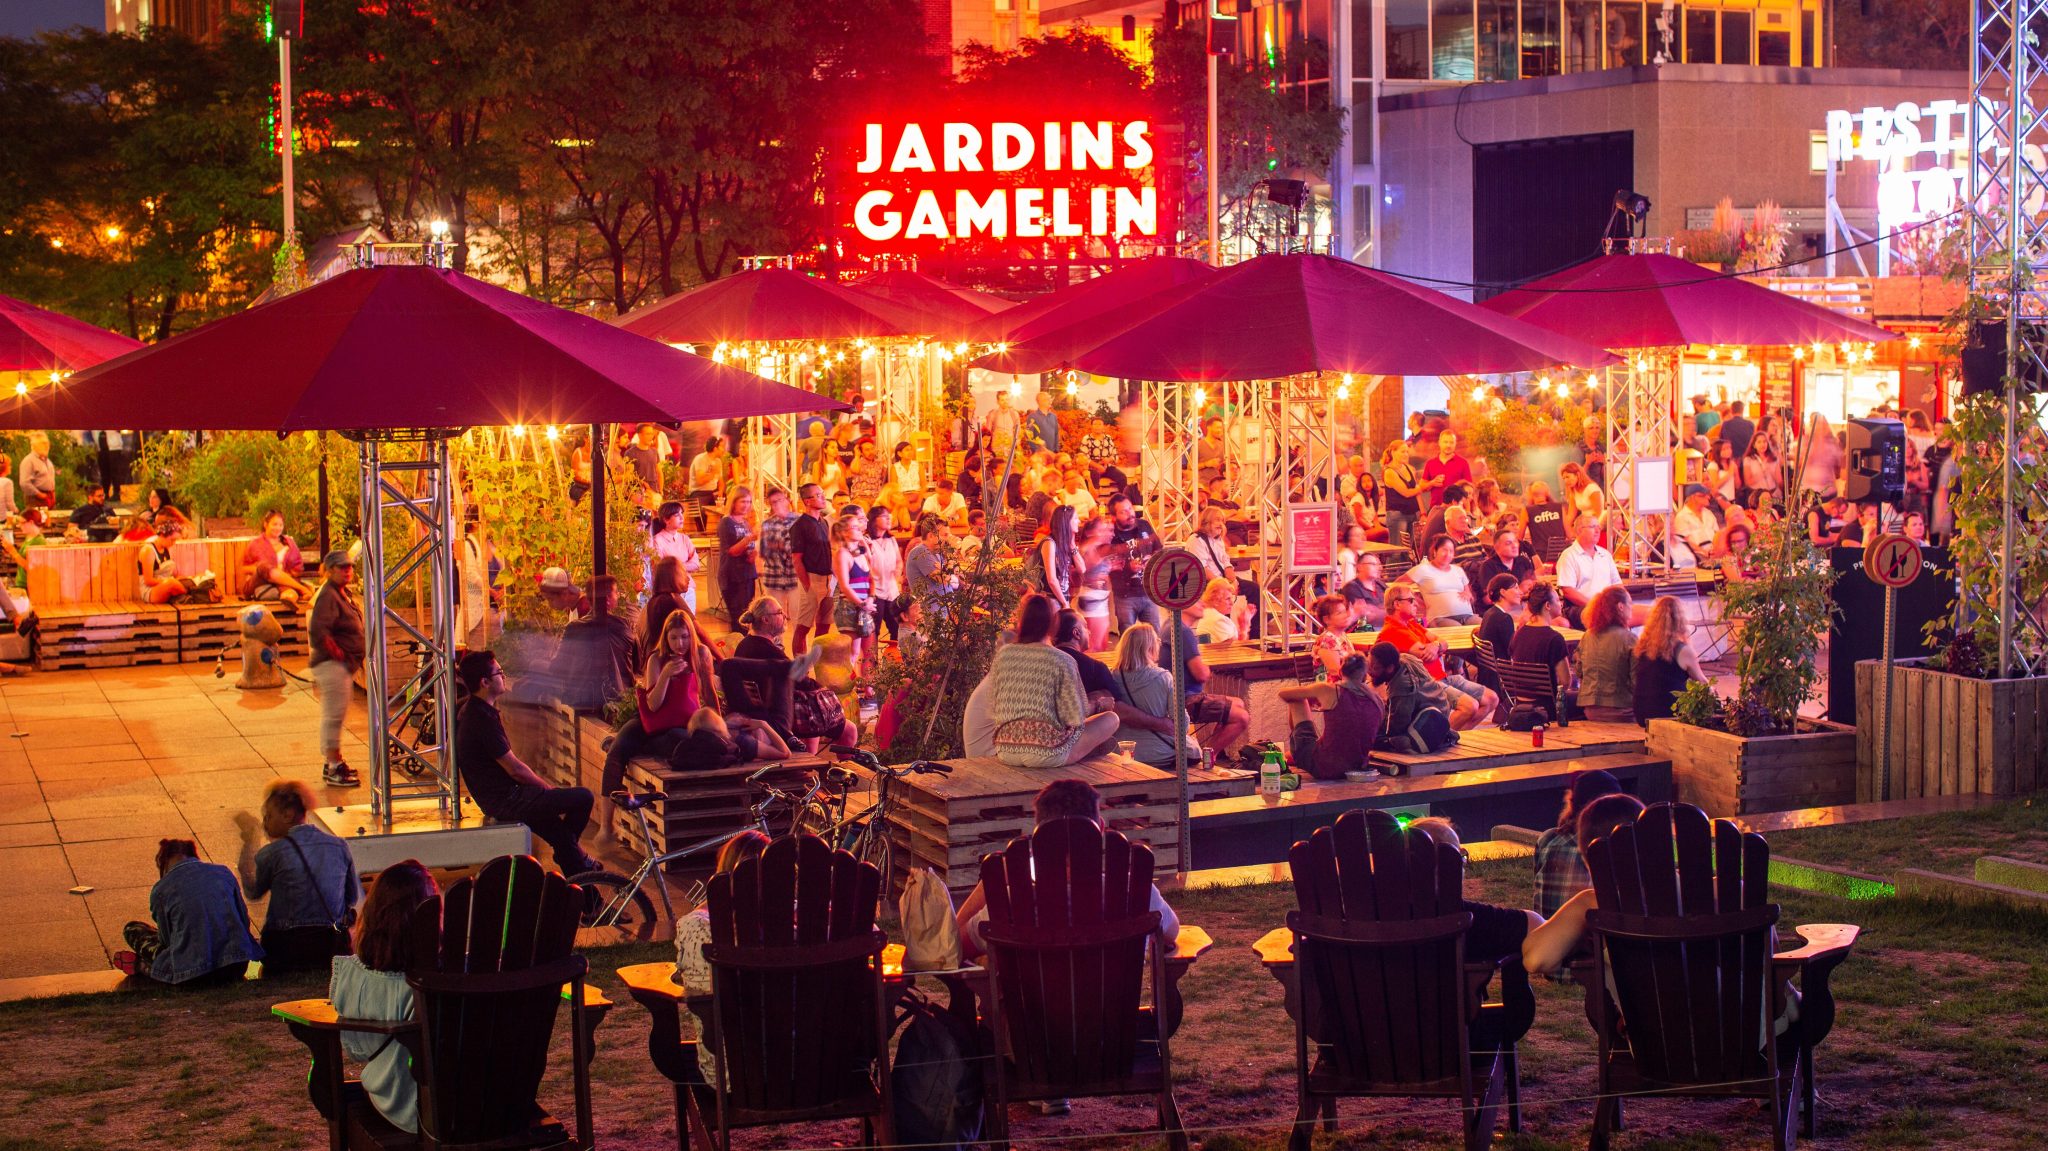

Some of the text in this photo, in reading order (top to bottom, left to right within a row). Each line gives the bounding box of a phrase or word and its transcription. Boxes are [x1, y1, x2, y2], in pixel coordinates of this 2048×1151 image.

[856, 121, 1154, 173] JARDINS
[854, 187, 1157, 241] GAMELIN
[1534, 511, 1560, 523] offta
